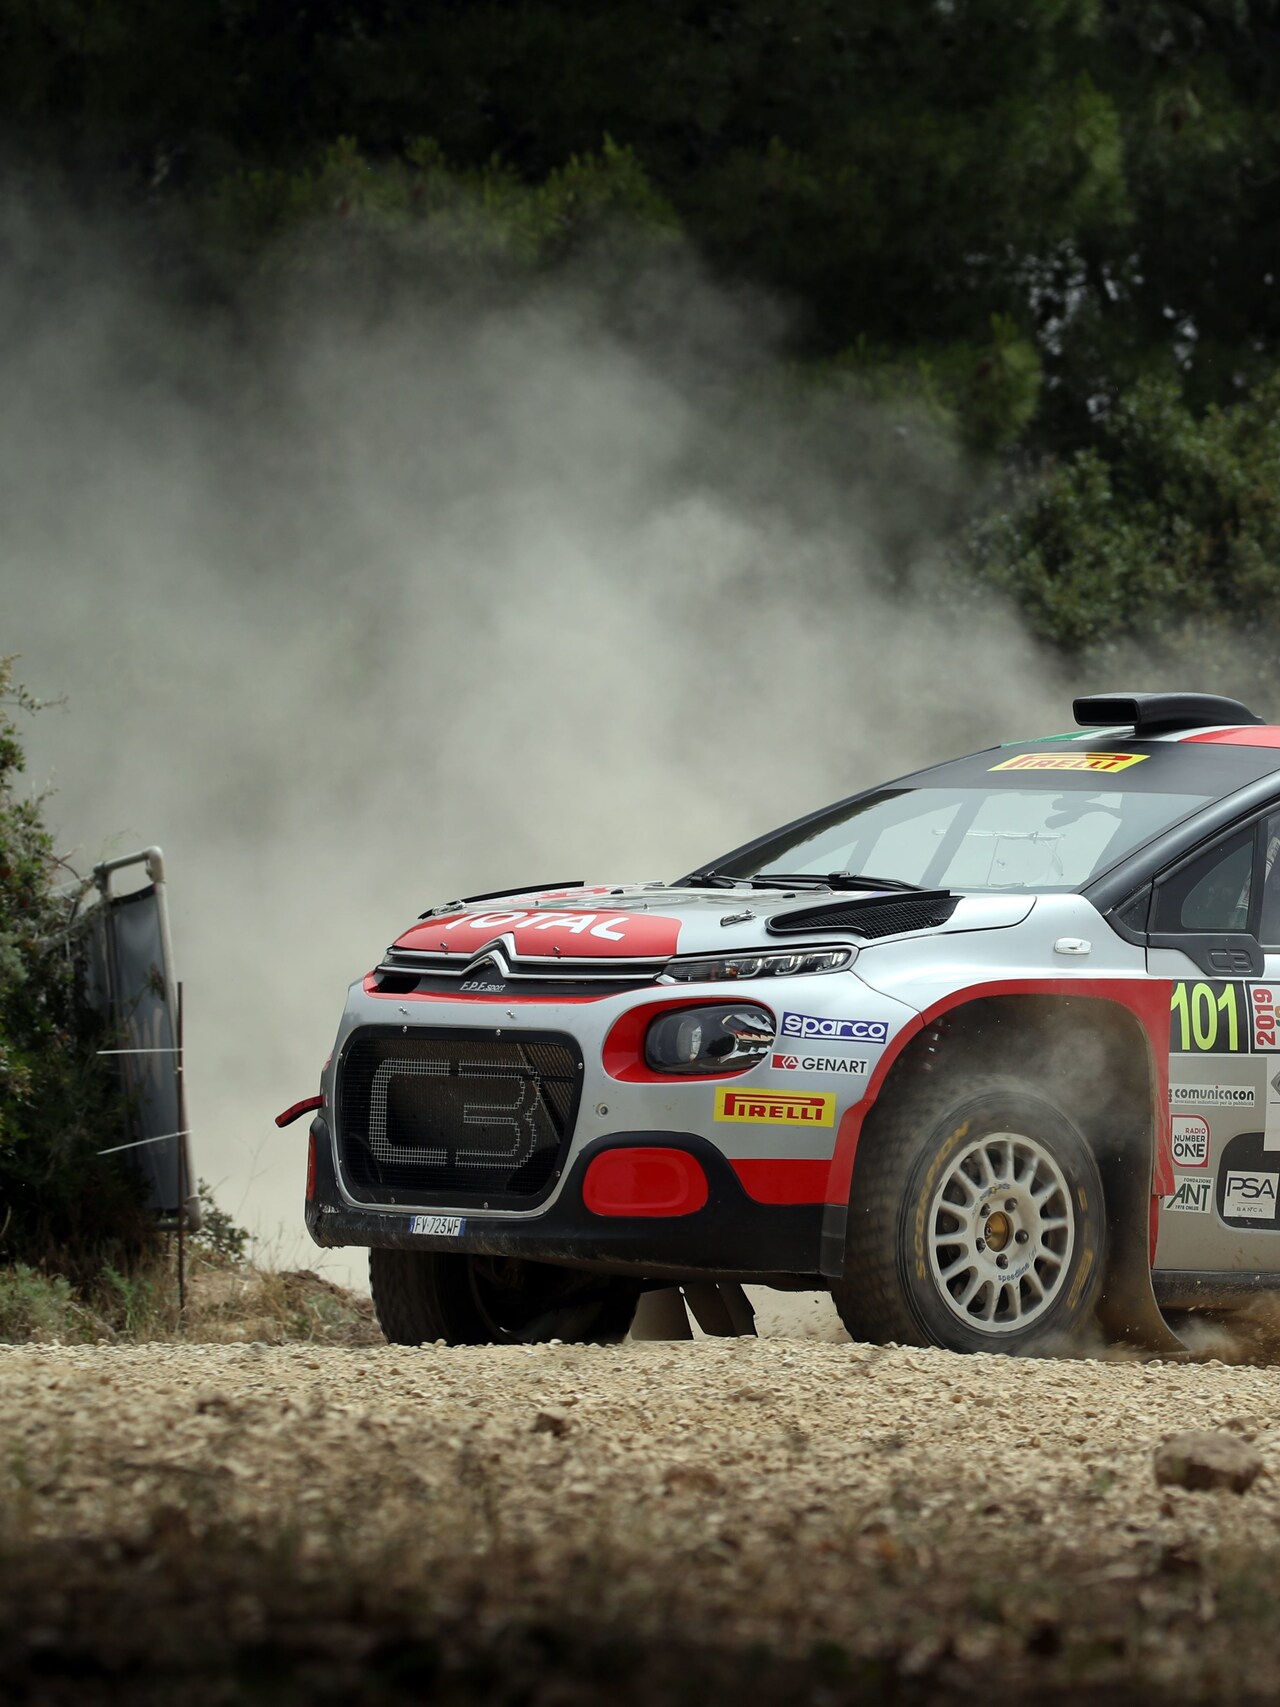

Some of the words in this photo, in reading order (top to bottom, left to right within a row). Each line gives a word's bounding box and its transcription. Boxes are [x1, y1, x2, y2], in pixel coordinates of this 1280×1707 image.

[1002, 753, 1133, 769] PIRELLI
[445, 910, 630, 941] TOTAL
[785, 1014, 886, 1040] sparco
[1171, 982, 1239, 1051] 101
[1253, 988, 1276, 1046] 2019
[802, 1057, 867, 1074] GENART
[1175, 1085, 1254, 1101] comunicacon
[369, 1058, 541, 1169] C3
[724, 1093, 826, 1121] PIRELLI
[1173, 1143, 1205, 1158] ONE
[1174, 1134, 1206, 1144] NUMBER
[1166, 1183, 1211, 1211] ANT
[1226, 1177, 1275, 1199] PSA
[1236, 1206, 1264, 1214] BANCA
